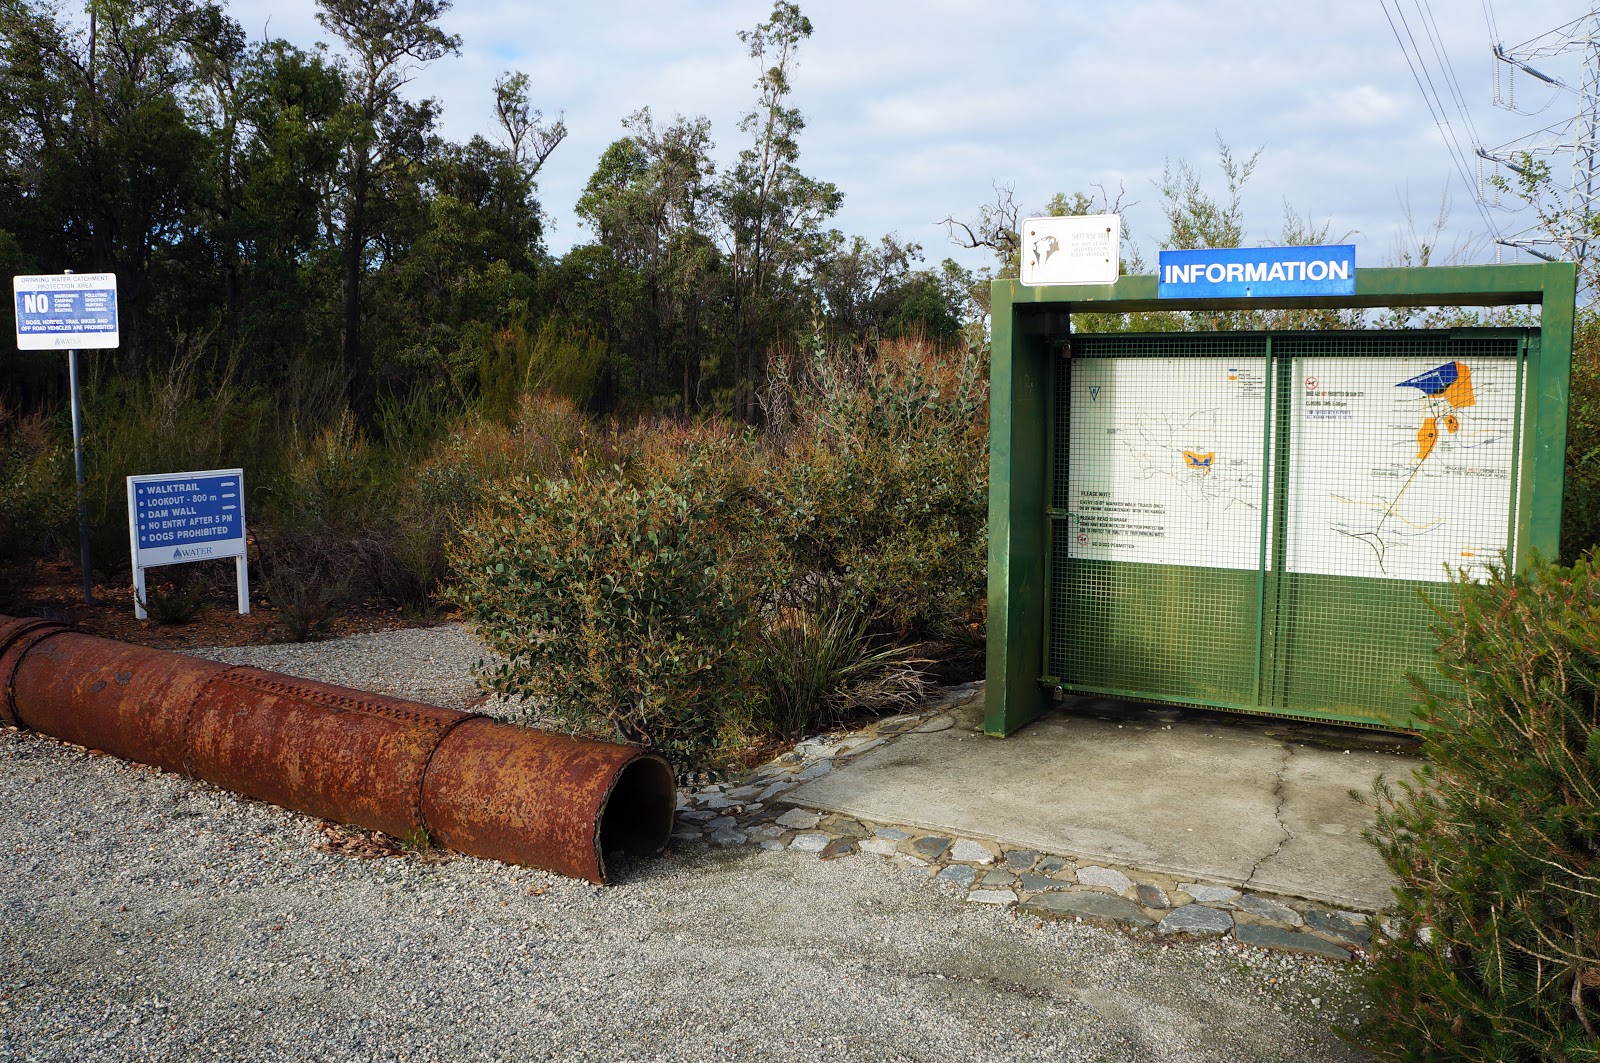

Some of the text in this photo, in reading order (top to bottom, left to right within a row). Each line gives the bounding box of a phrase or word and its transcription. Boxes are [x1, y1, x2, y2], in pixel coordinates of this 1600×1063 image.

[1165, 260, 1349, 284] INFORMATION
[24, 294, 49, 314] NO
[147, 483, 200, 494] WALKTRAIL
[147, 496, 184, 507] LOOKOUT
[192, 494, 207, 502] 800
[148, 507, 196, 518] DAM WALL
[148, 522, 160, 530] NO
[162, 519, 186, 528] ENTRY
[189, 516, 212, 526] AFTER
[149, 526, 228, 541] DOGS PROHIBITED
[181, 546, 212, 556] WATER
